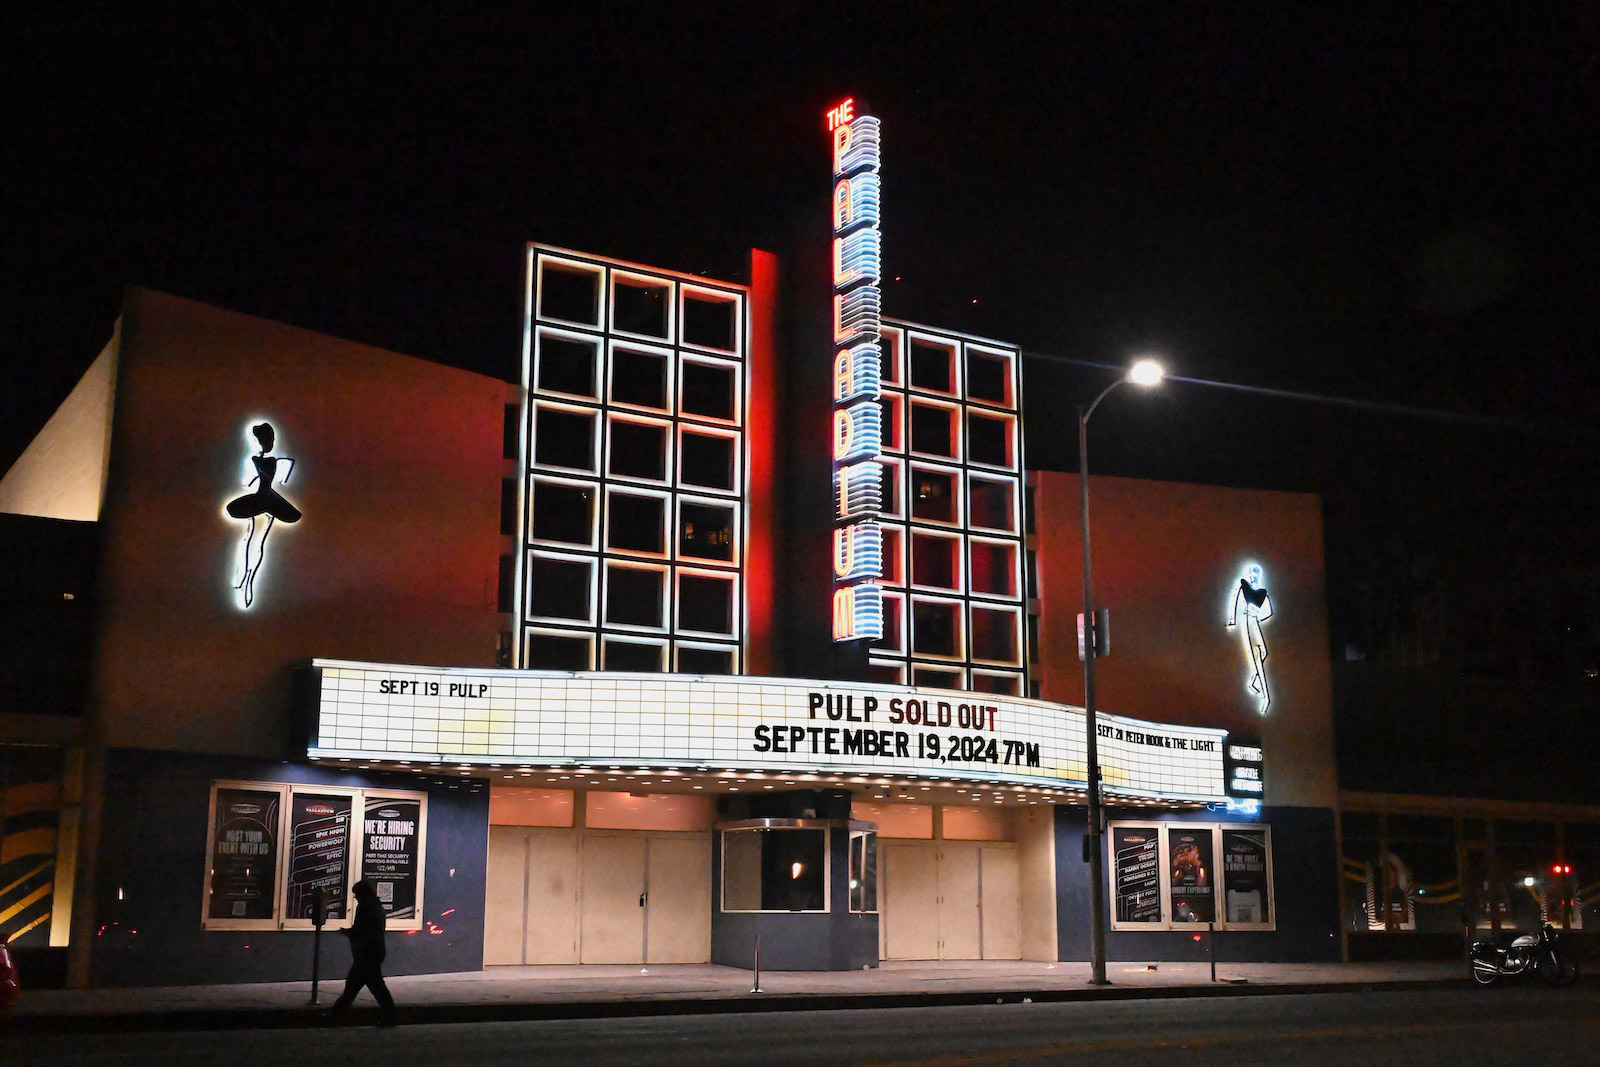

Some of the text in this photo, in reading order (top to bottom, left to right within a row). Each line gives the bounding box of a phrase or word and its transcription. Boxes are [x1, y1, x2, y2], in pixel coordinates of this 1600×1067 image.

[826, 98, 854, 131] THE
[833, 124, 854, 639] PALLADIUM
[380, 680, 488, 698] SEPT 19 PULP
[808, 692, 998, 732] PULP SOLD OUT
[753, 724, 909, 758] SEPTEMBER
[1002, 739, 1040, 768] 7PM
[1097, 724, 1114, 738] SEPT
[1126, 730, 1145, 744] PETER
[1146, 734, 1164, 747] HOOK
[1172, 738, 1188, 750] THE
[1190, 739, 1215, 752] LIGHT
[226, 830, 263, 842] HOST YOUR
[365, 820, 414, 836] WE'RE HIRING
[218, 842, 269, 855] EVENT WITH US
[308, 838, 344, 850] POWERWOLF
[370, 836, 406, 850] SECURITY
